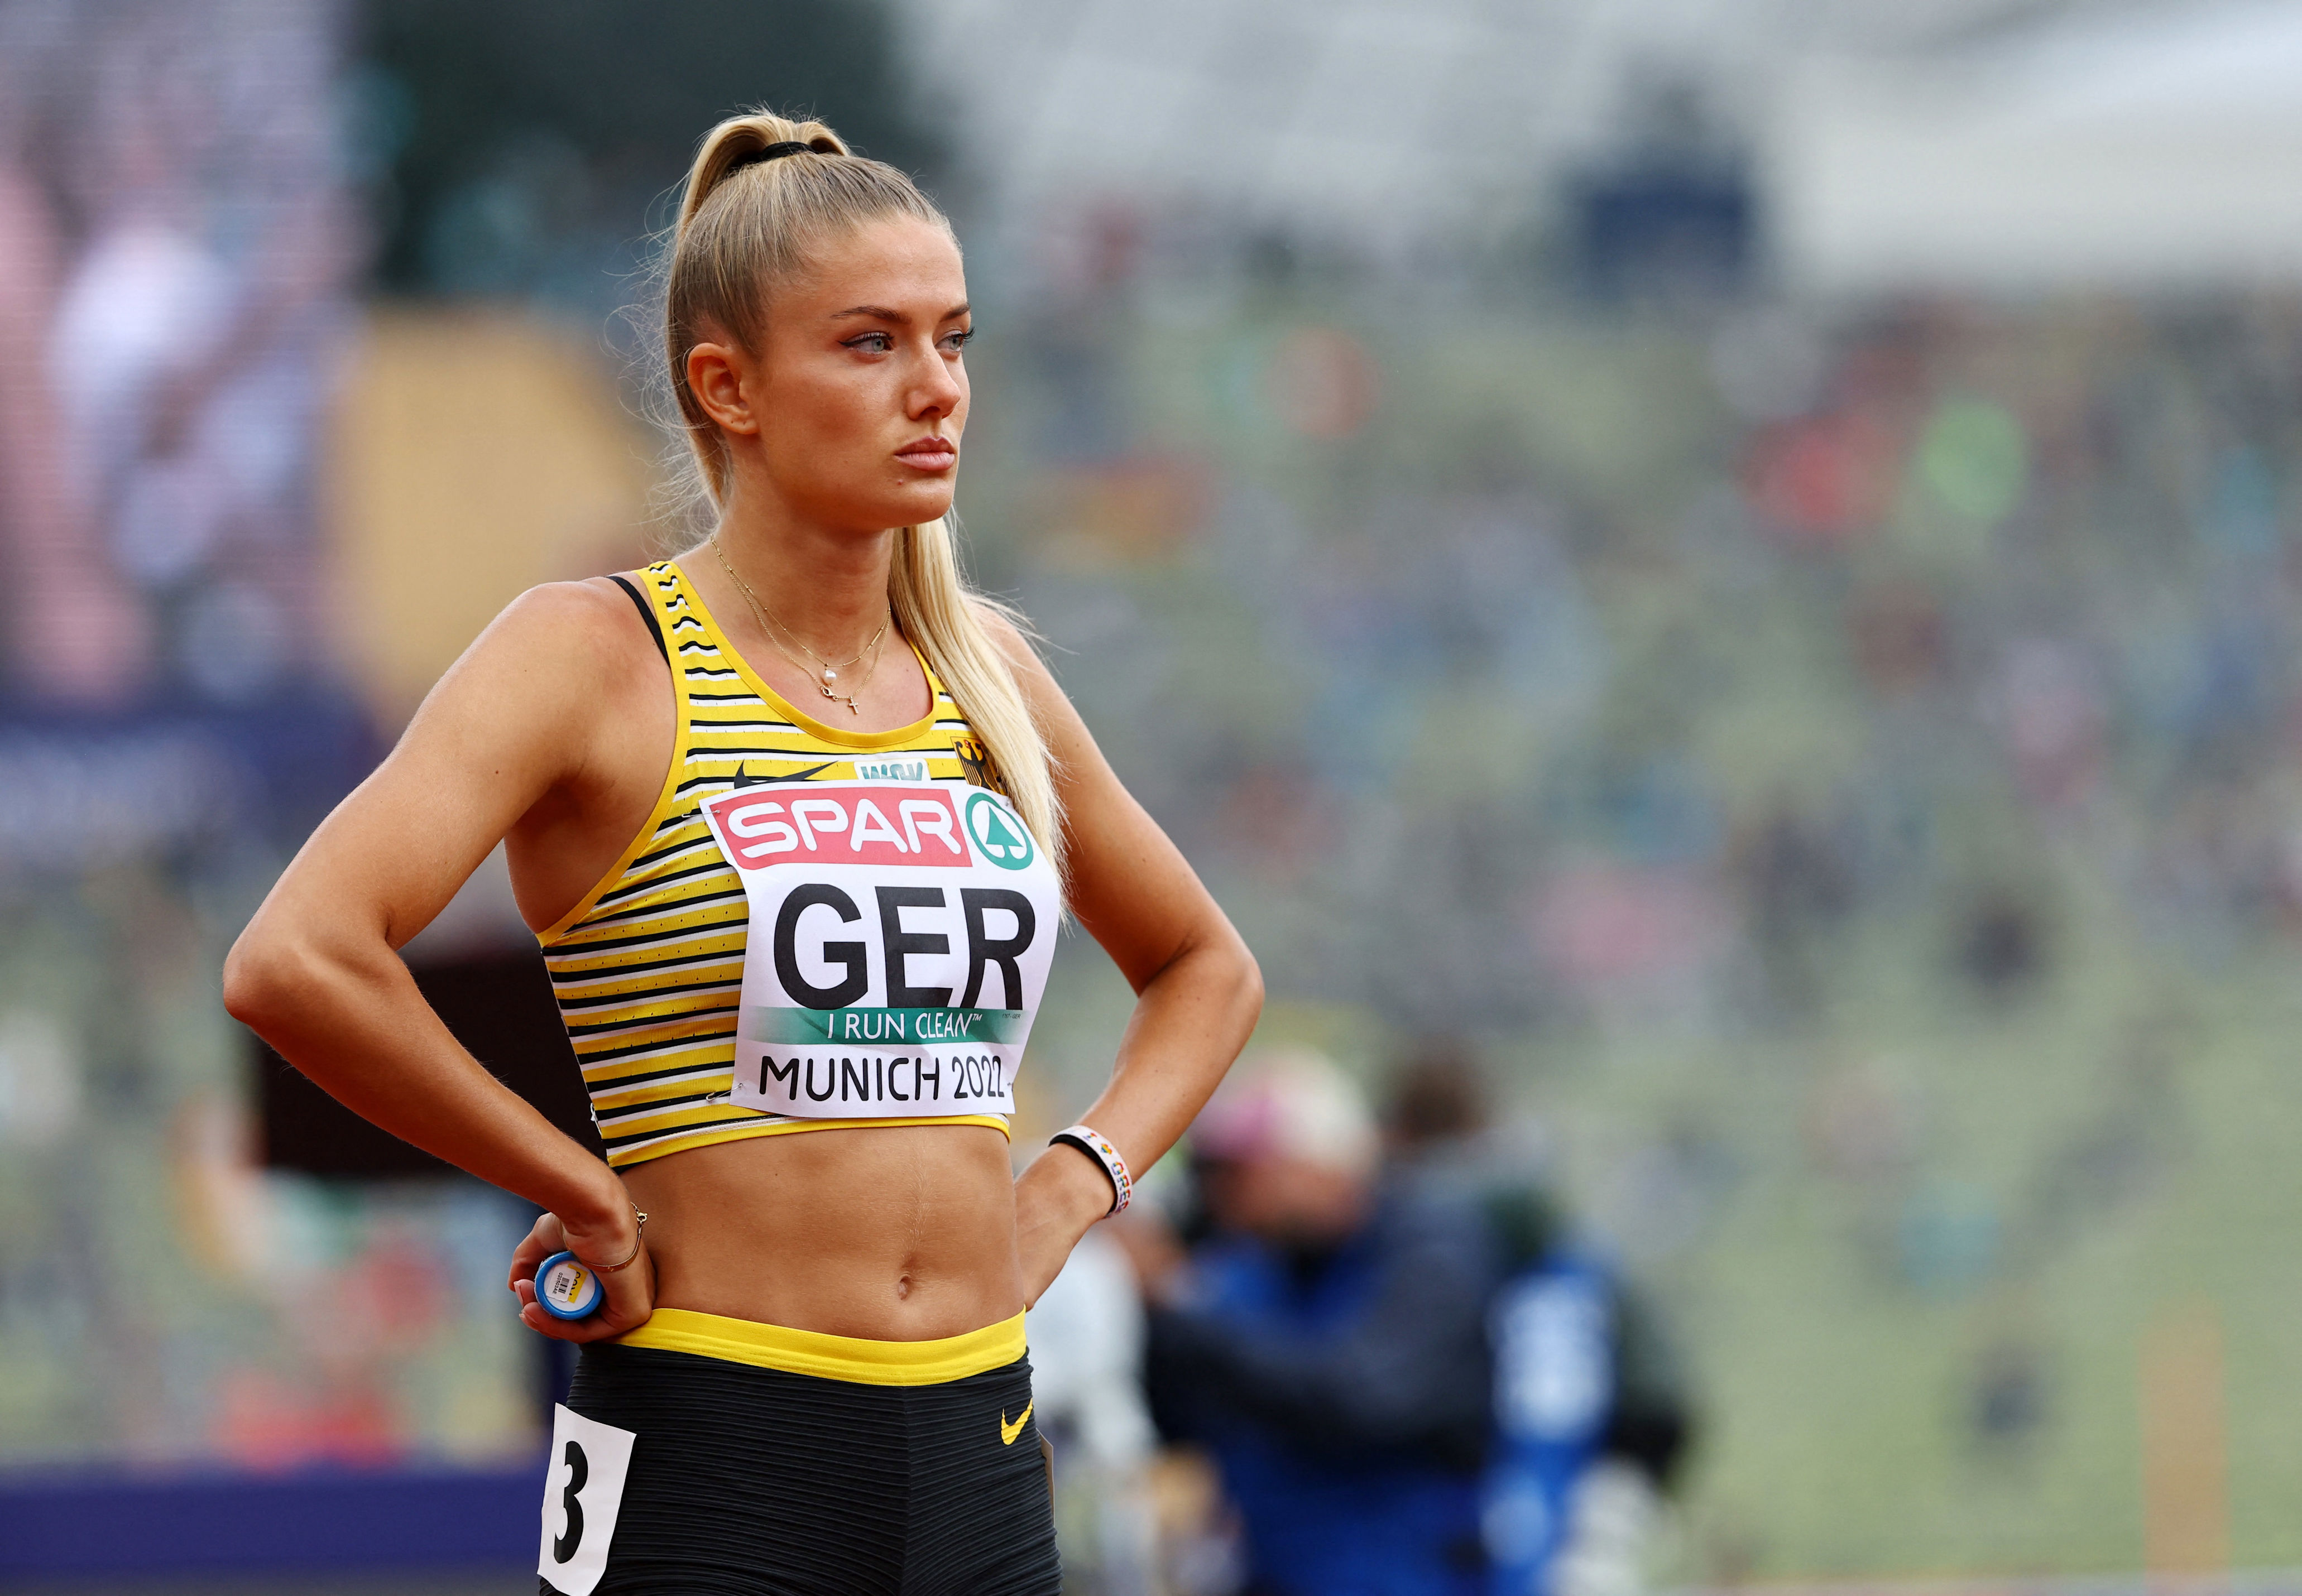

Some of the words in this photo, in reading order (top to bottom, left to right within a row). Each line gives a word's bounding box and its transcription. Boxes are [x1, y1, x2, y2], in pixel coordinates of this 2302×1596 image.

[728, 798, 962, 858] SPAR
[774, 883, 1035, 1011] GER
[827, 1013, 833, 1039] I
[845, 1012, 904, 1039] RUN
[759, 1055, 940, 1101] MUNICH
[951, 1056, 1005, 1099] 2022
[554, 1441, 588, 1564] 3
